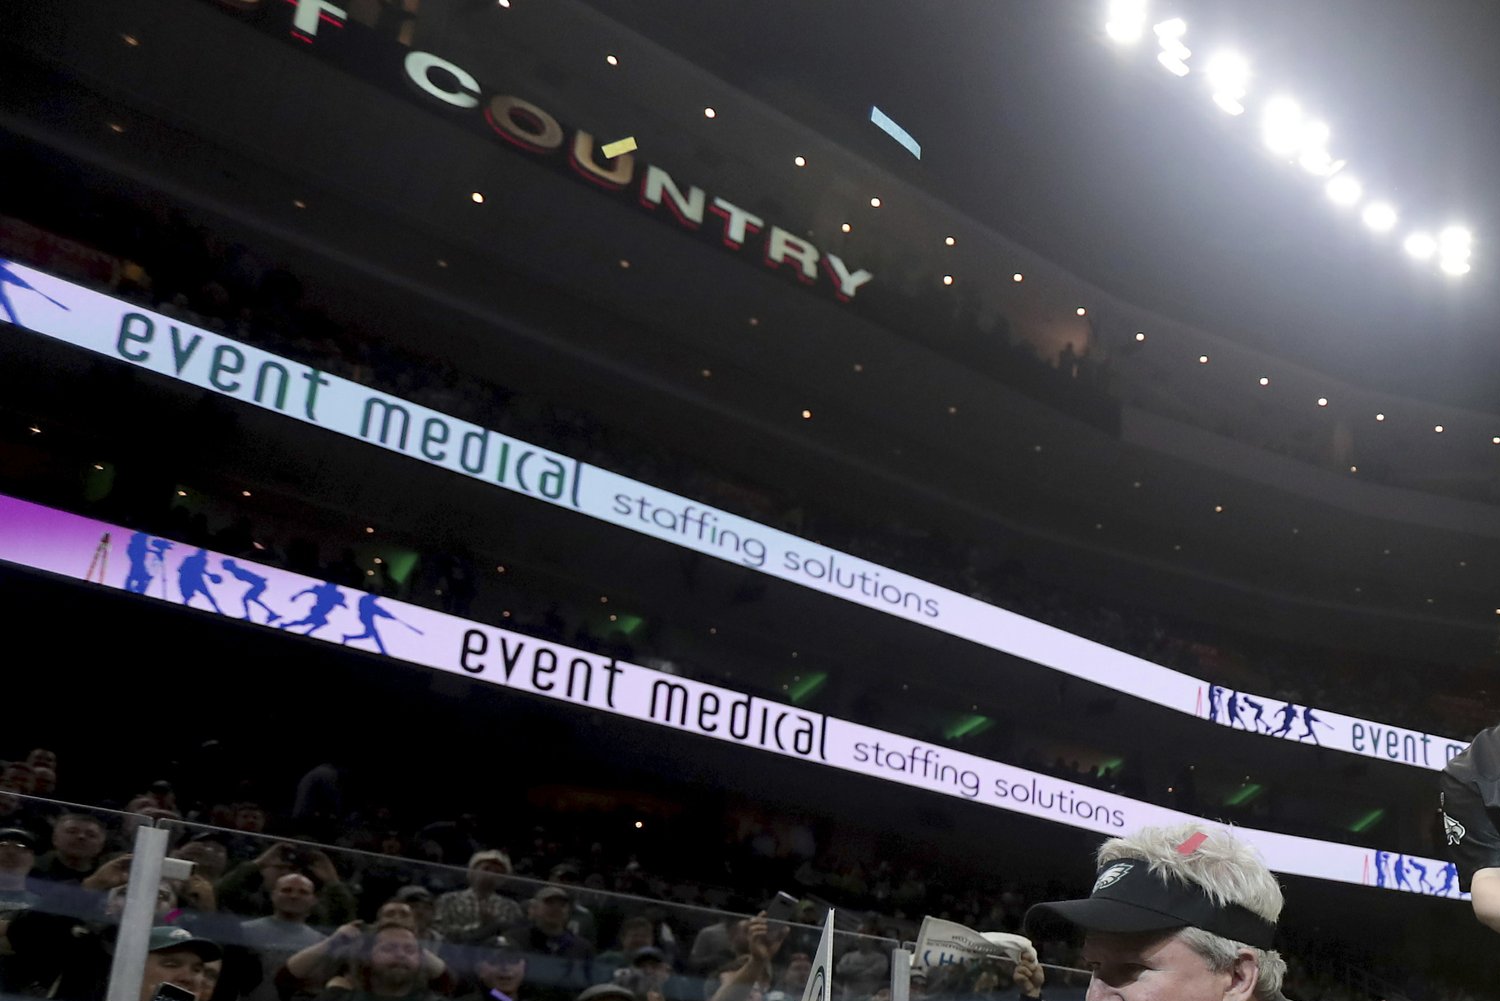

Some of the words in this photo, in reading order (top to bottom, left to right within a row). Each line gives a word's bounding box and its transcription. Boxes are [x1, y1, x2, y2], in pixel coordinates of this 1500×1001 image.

[404, 51, 873, 300] COUNTRY
[116, 311, 329, 421] event
[359, 394, 585, 508] medical
[613, 492, 767, 568] staffing
[783, 548, 939, 618] solutions
[460, 628, 622, 709] event
[650, 679, 828, 760] medical
[853, 741, 980, 798] staffing
[994, 778, 1125, 828] solutions
[1352, 722, 1431, 766] event
